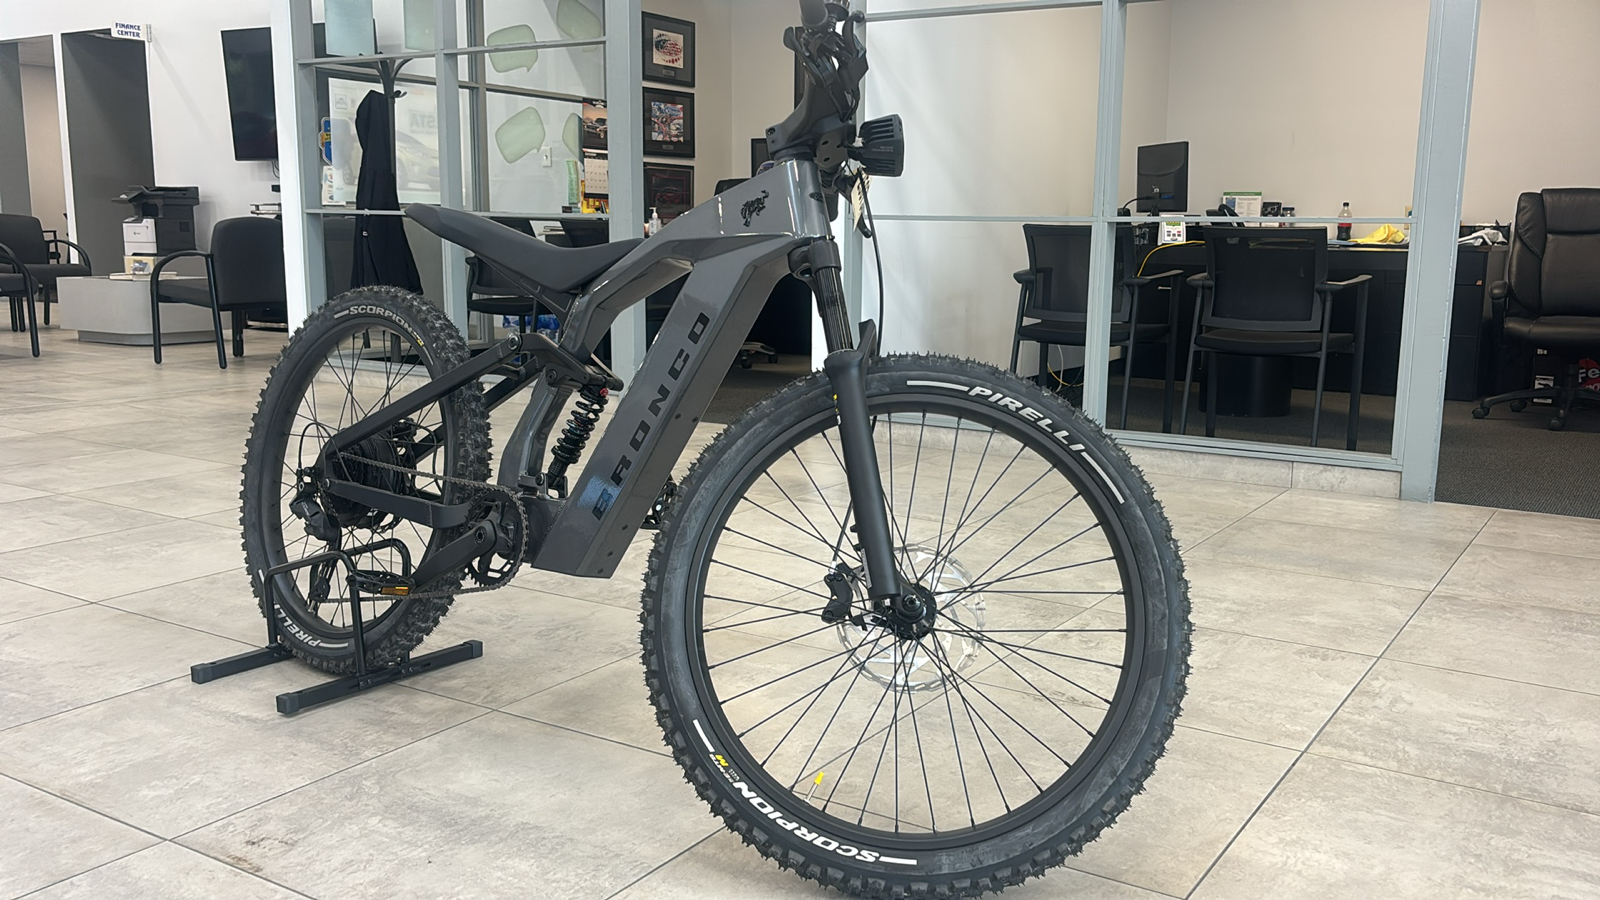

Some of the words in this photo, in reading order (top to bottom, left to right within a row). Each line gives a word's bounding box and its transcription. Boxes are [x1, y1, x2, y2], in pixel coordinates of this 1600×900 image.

[115, 22, 141, 31] FINANCE
[117, 30, 141, 38] CENTER
[349, 305, 413, 333] SCORPION
[592, 312, 710, 521] BRONCO
[968, 386, 1086, 451] PIRELLI
[733, 781, 880, 863] SCORPION
